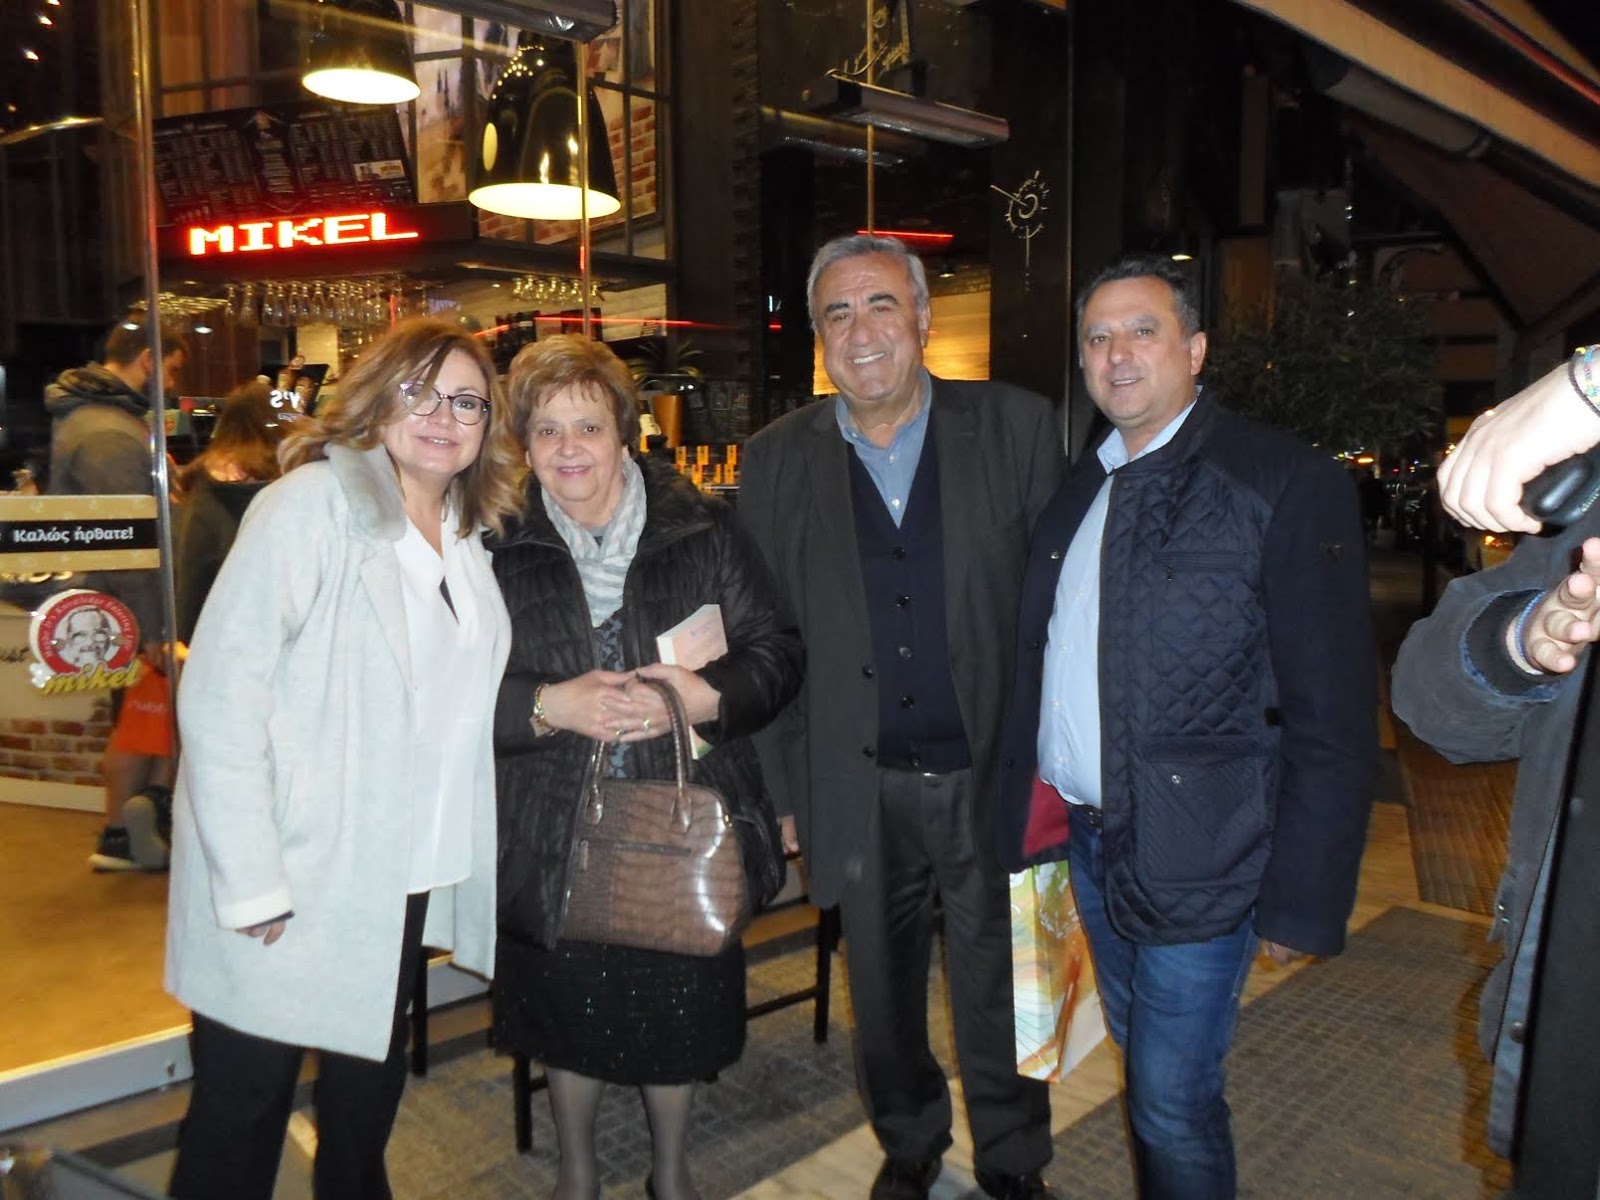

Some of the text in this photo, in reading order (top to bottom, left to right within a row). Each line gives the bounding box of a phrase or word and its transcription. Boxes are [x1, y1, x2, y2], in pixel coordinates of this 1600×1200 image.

[190, 212, 419, 255] MIKEL
[13, 526, 134, 544] Καλώς ήρθατε!
[43, 658, 140, 694] mikel
